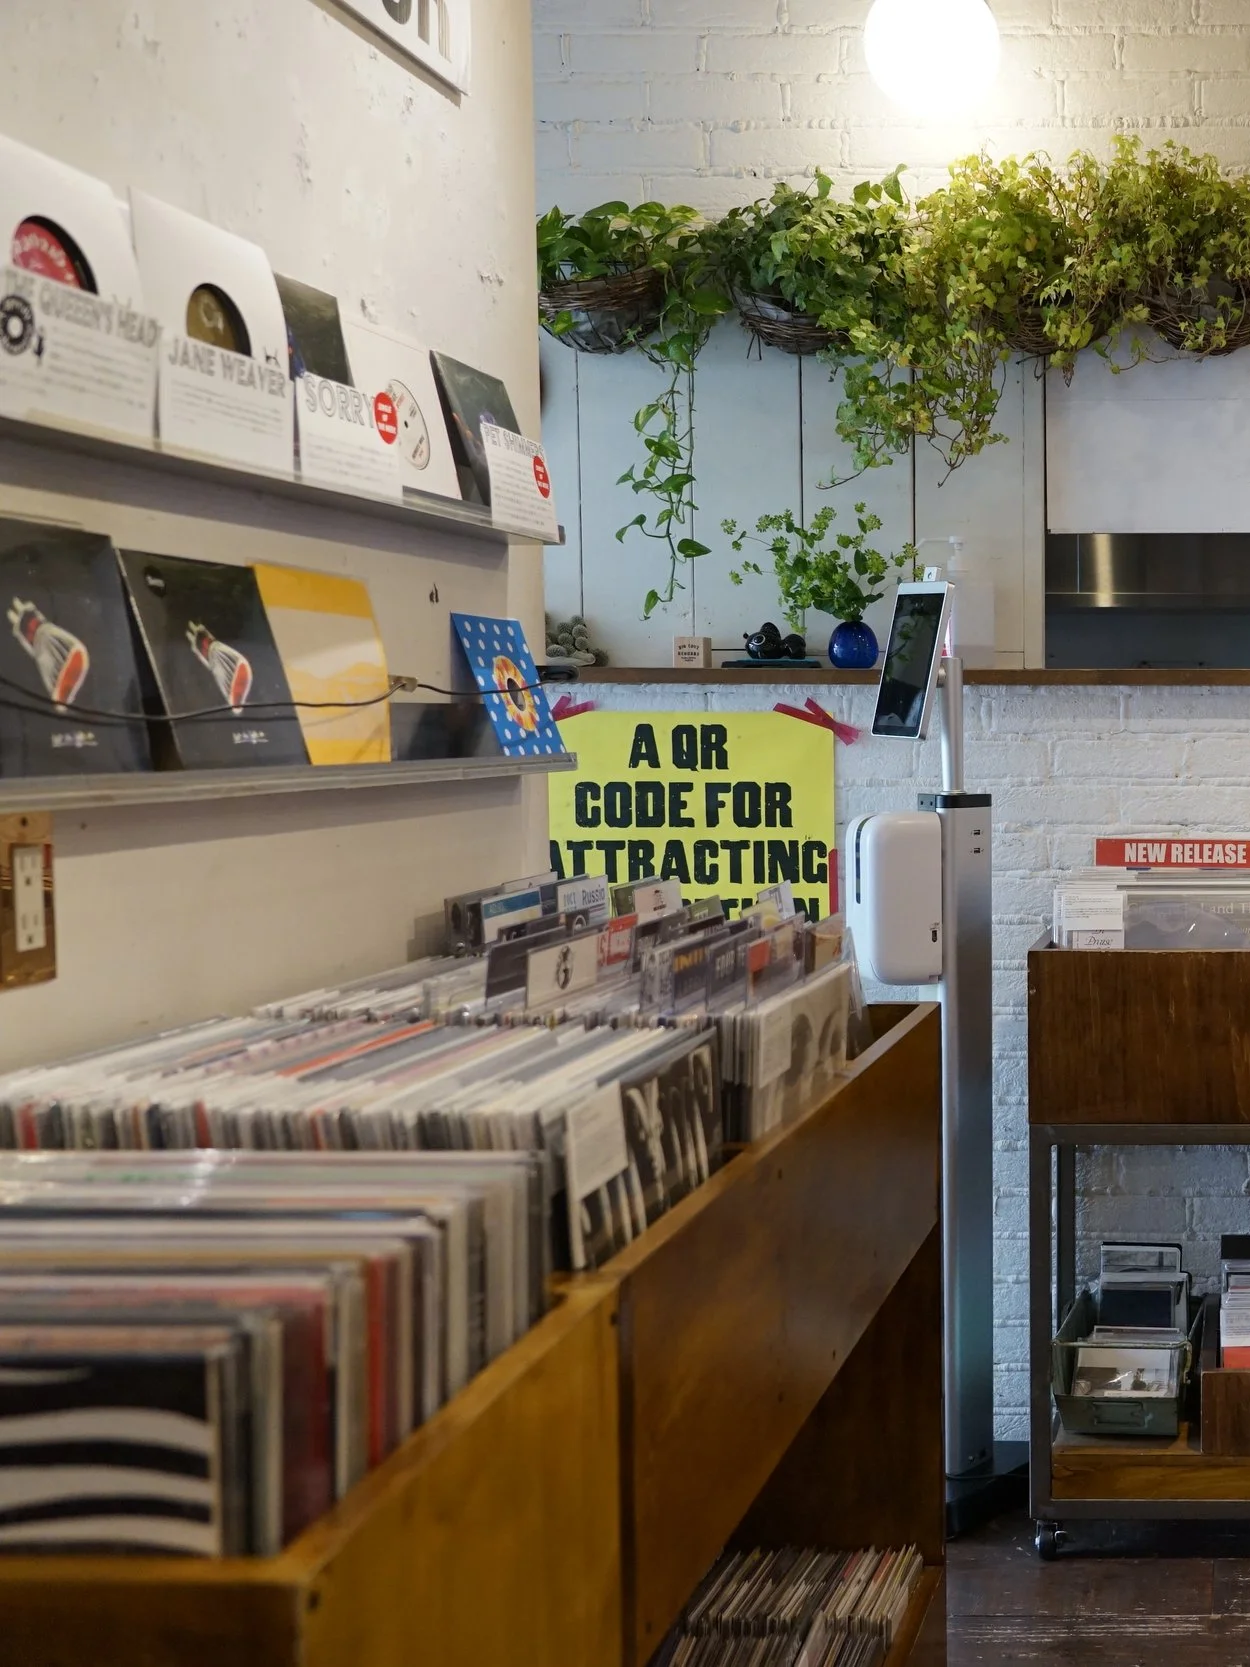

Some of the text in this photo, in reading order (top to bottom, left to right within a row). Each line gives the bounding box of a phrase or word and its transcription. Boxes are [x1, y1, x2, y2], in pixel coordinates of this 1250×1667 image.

[168, 338, 217, 378] JANE
[219, 350, 287, 399] WEAVER
[304, 372, 377, 429] SORRY
[482, 424, 501, 448] PET
[628, 723, 729, 772] A QR
[575, 781, 793, 829] CODE FOR
[1124, 842, 1247, 864] NEW RELEASE
